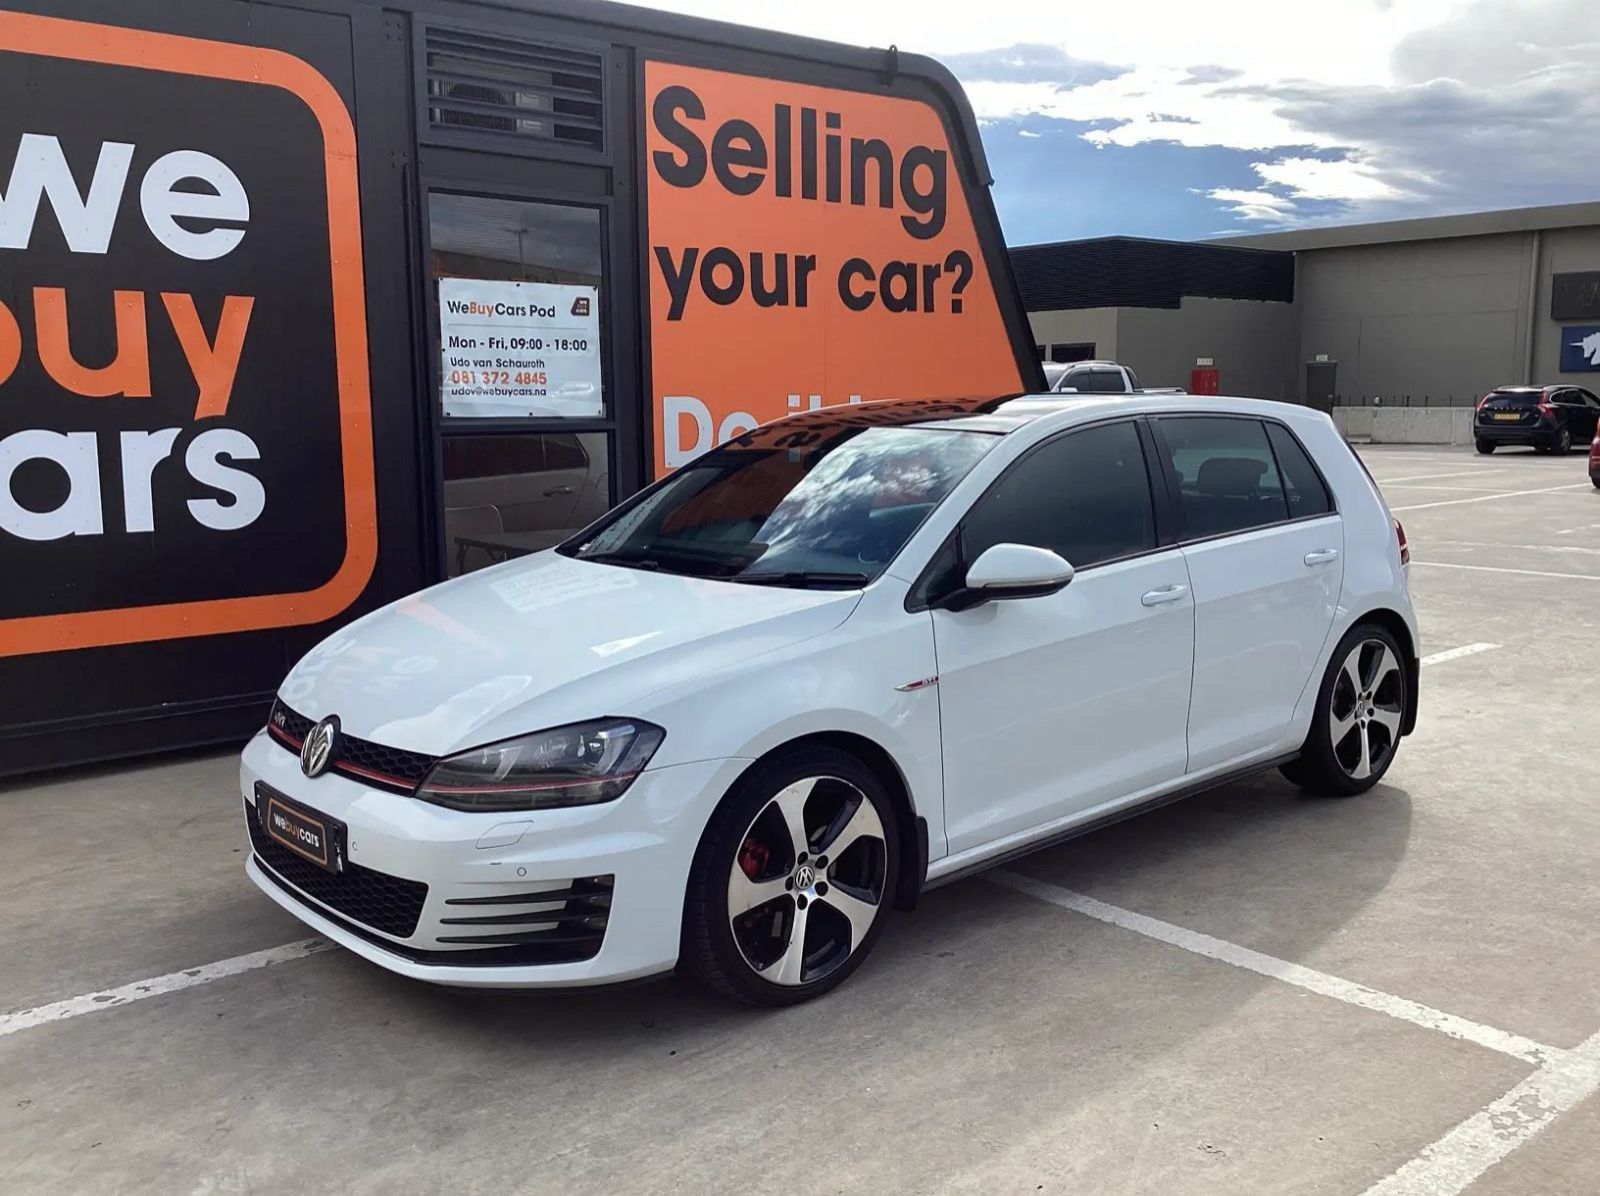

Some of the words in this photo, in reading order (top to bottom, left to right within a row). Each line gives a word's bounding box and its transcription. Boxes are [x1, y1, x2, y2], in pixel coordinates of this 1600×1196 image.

[652, 85, 947, 240] Selling
[0, 132, 250, 260] we
[653, 246, 816, 321] your
[837, 249, 974, 314] car?
[447, 301, 527, 317] WeBuyCars
[529, 304, 556, 318] Pod
[0, 285, 255, 421] uy
[448, 336, 476, 348] Mon
[488, 337, 508, 350] Fri,
[510, 338, 542, 350] 09:00
[554, 339, 587, 351] 18:00
[450, 356, 470, 368] Udo
[473, 359, 492, 368] van
[495, 358, 545, 369] Schauroth
[451, 370, 477, 384] 081
[481, 371, 510, 385] 372
[514, 372, 548, 385] 4845
[273, 812, 320, 847] webuycars
